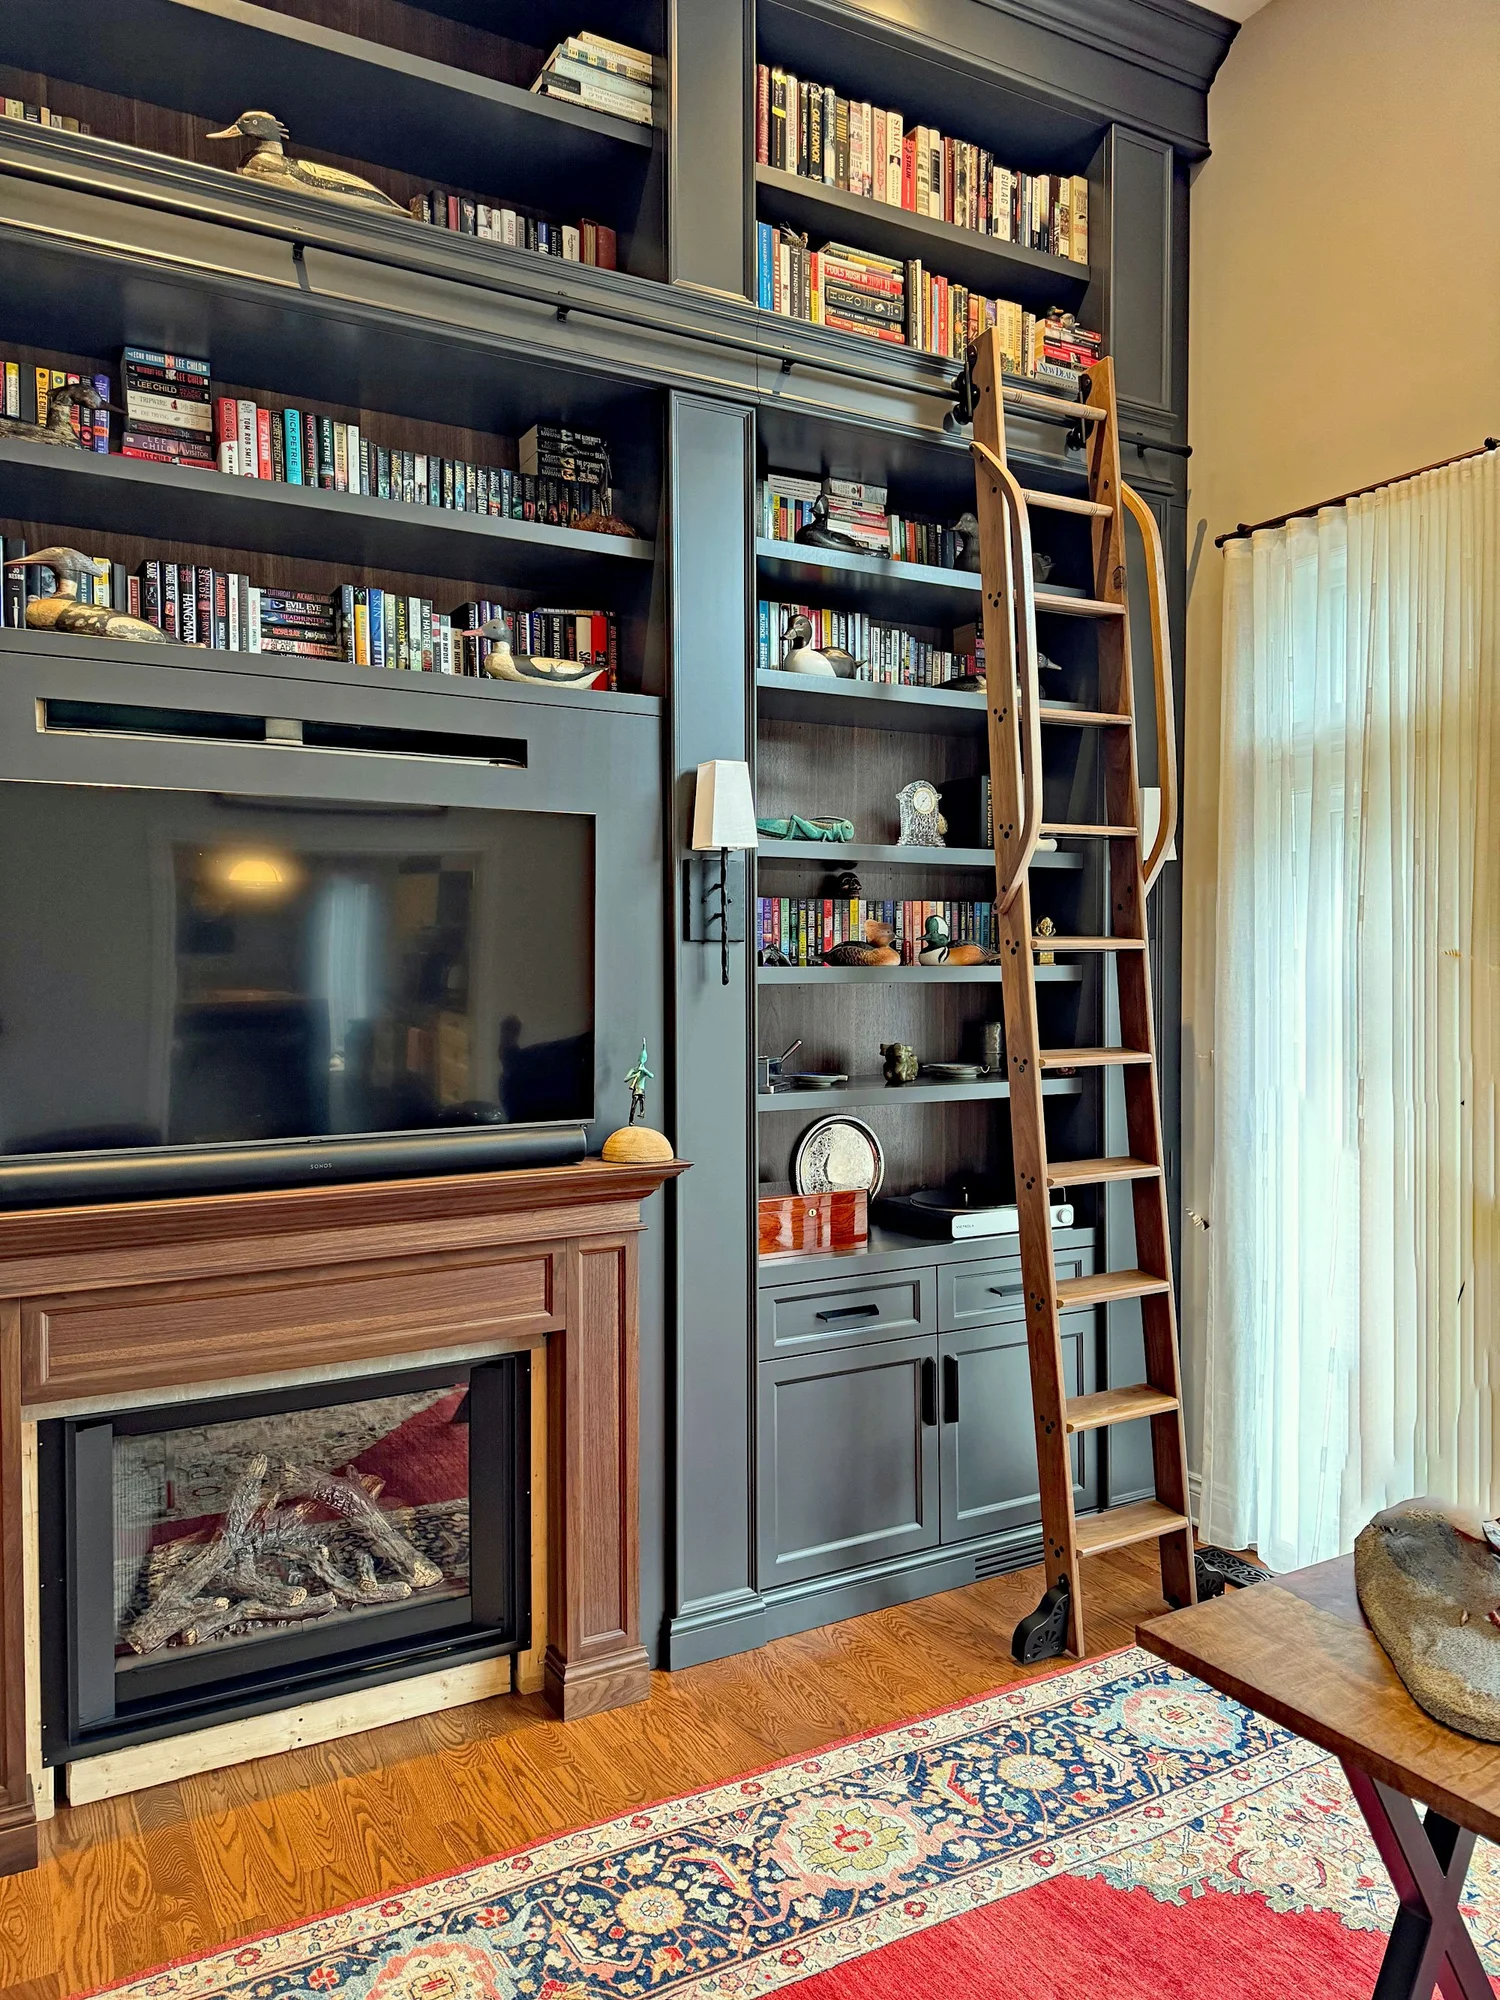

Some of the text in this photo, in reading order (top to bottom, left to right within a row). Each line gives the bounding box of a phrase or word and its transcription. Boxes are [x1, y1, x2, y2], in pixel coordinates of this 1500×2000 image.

[812, 108, 820, 122] OIL
[812, 130, 820, 163] HONOR
[1001, 174, 1009, 204] GULAG
[762, 229, 768, 238] ON
[826, 264, 868, 283] FOOLS RUSH IN
[133, 351, 145, 360] ECHO
[175, 358, 202, 371] LEE CHILD
[1040, 363, 1077, 380] NEW DEALS
[176, 373, 203, 386] LEE CHILD
[137, 381, 177, 394] LEE CHILD
[39, 387, 47, 421] LEE CHILD
[140, 396, 167, 407] TRIPWIRE
[224, 402, 234, 440] CHILD 44
[243, 417, 251, 430] TOM
[142, 442, 172, 452] CHILD
[147, 436, 166, 445] LEE
[260, 426, 269, 460] FARM
[306, 415, 315, 469] NICK PETRIE
[185, 448, 208, 458] VISITOR
[290, 435, 298, 466] PETRIE
[478, 499, 486, 514] STAR
[147, 562, 156, 578] SLADE
[165, 564, 174, 600] MICHAEL SLADE
[217, 576, 226, 617] HEADHUNTER
[267, 589, 291, 598] CUTTHROAT
[296, 593, 315, 601] MICHAEL
[240, 579, 248, 626] CRUCIFIED
[285, 601, 322, 612] EVIL EYE
[373, 595, 381, 618] SKIN
[399, 602, 405, 615] MO
[183, 593, 194, 642] HANGMAN
[280, 614, 325, 624] HEADHUNTER
[422, 605, 431, 648] MO HAYDER
[443, 632, 448, 641] MO
[270, 643, 296, 652] SLADE
[454, 640, 461, 650] MO
[423, 650, 432, 671] GONE
